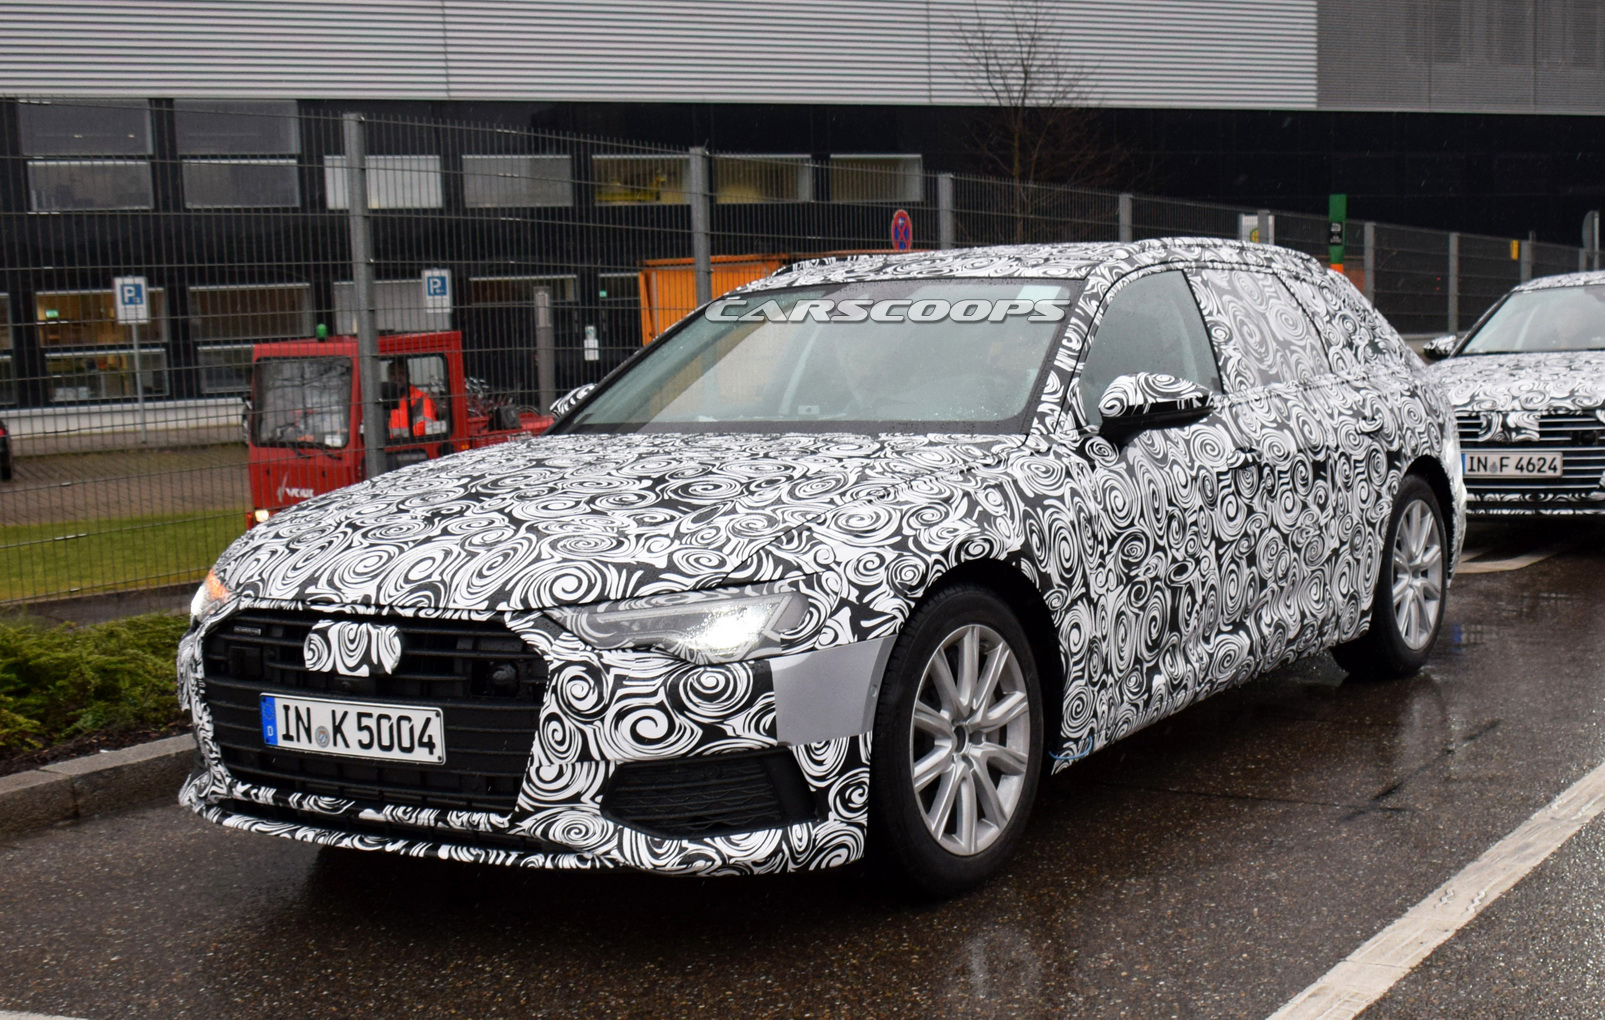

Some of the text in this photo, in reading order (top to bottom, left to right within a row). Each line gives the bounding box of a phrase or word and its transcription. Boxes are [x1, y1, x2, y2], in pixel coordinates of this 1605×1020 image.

[123, 286, 136, 303] P
[430, 278, 442, 294] P
[1467, 456, 1558, 473] IN F 4624
[282, 704, 436, 755] IN K 5004
